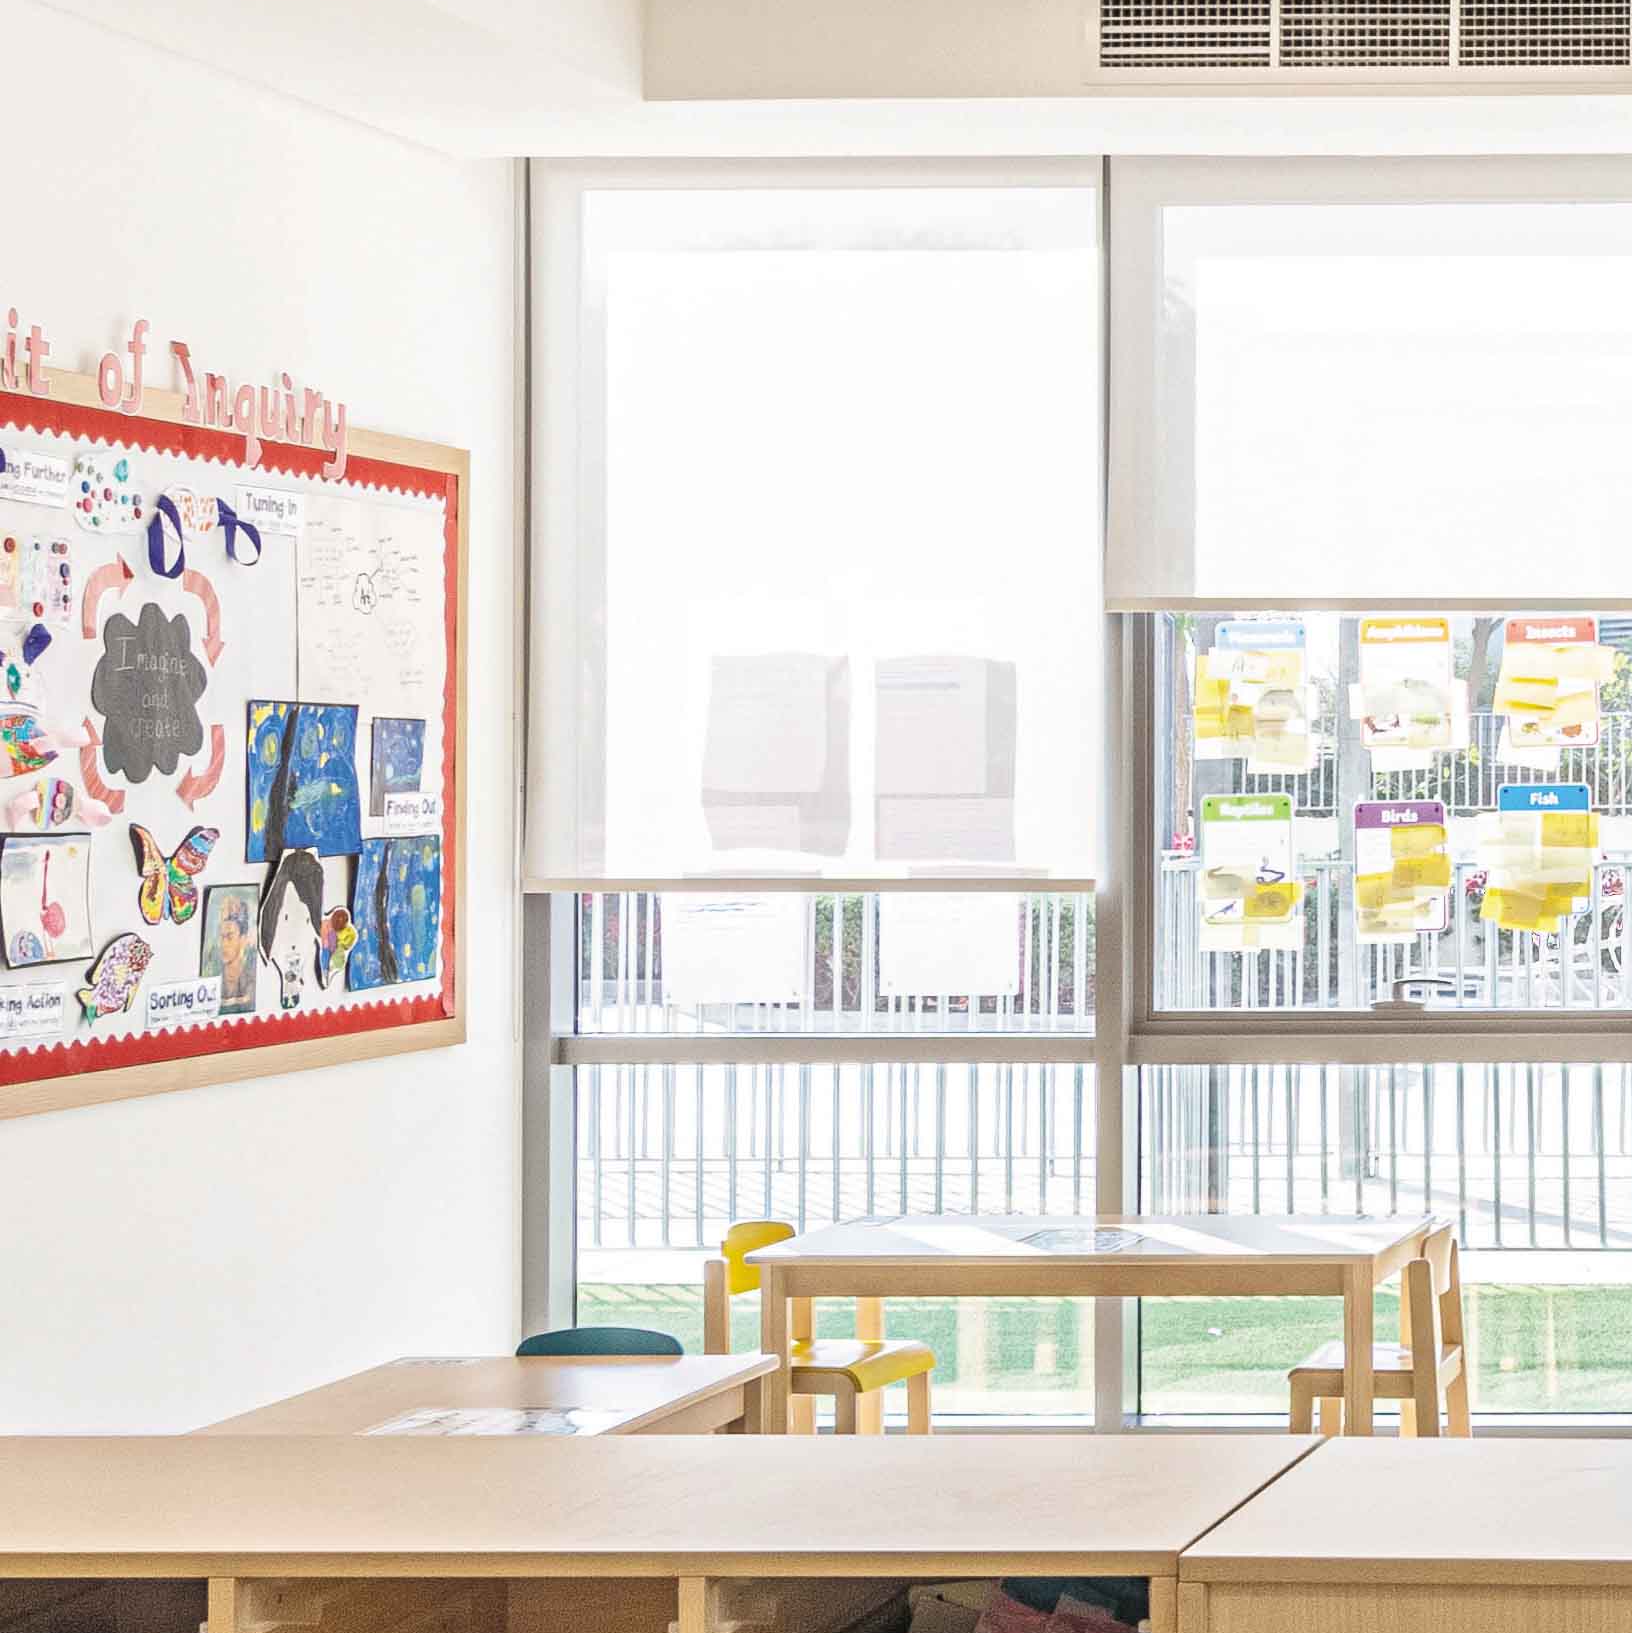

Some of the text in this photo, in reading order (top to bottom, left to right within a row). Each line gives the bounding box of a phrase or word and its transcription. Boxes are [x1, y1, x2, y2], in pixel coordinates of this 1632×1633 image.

[98, 319, 149, 415] of
[169, 340, 347, 481] Inquiry
[24, 462, 66, 483] Further
[245, 492, 284, 518] Tuning
[1529, 791, 1560, 807] Fish
[1381, 808, 1419, 825] Birds
[150, 991, 195, 1010] Sorting
